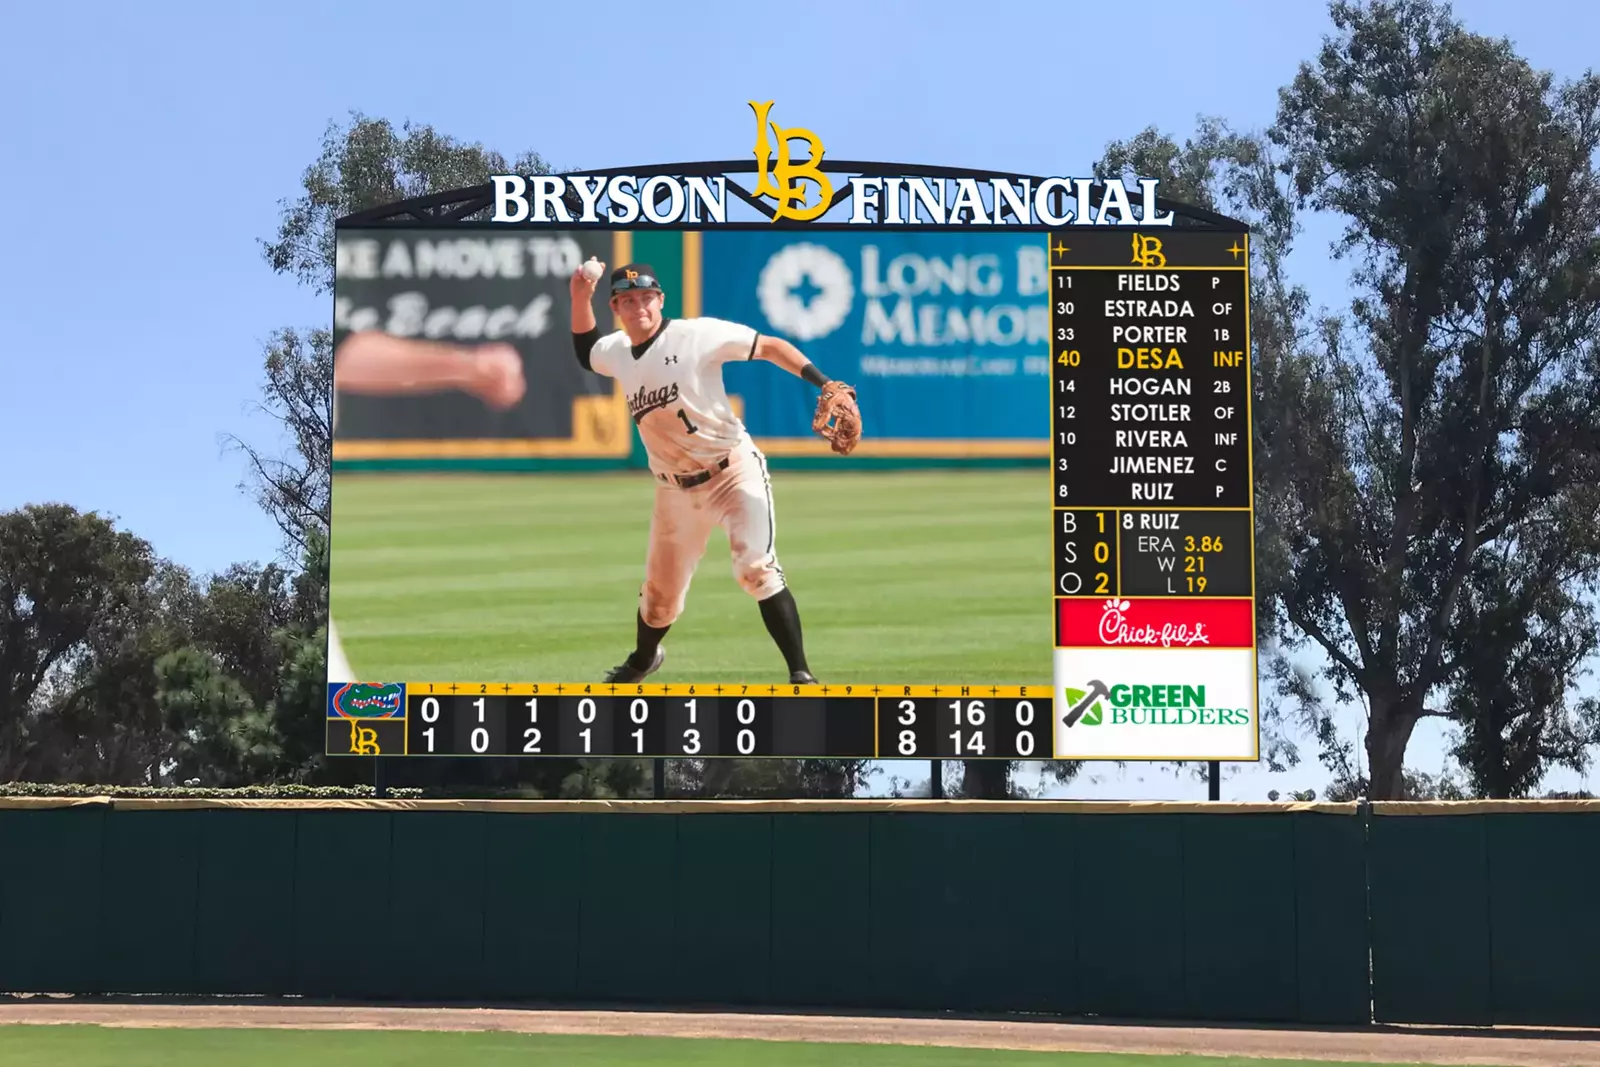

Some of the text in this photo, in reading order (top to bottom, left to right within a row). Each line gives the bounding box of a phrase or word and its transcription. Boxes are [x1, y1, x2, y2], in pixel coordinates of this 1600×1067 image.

[491, 174, 1174, 226] BRYSON FINANCIAL
[1059, 275, 1219, 291] 11 FIELDS P
[1058, 300, 1232, 317] 30 ESTRADA OF
[1058, 326, 1229, 343] 33 PORTER 1B
[1058, 351, 1080, 366] 40
[1118, 348, 1183, 369] DESA
[1214, 352, 1243, 367] INF
[1060, 378, 1230, 395] 14 HOGAN 2B
[1060, 404, 1234, 421] 12 STOTLER OF
[677, 409, 698, 434] 1
[1060, 431, 1237, 447] 10 RIVERA INF
[1059, 457, 1226, 473] 3 JIMENEZ C
[1060, 483, 1223, 500] 8 RUIZ P
[1064, 513, 1104, 533] B 1
[1123, 513, 1179, 529] 8 RUIZ
[1065, 542, 1108, 563] S 0
[1139, 536, 1223, 552] ERA 3.86
[1158, 556, 1203, 572] W 21
[1095, 573, 1108, 593] 2
[1168, 577, 1207, 593] L 19
[1098, 597, 1210, 648] Chick-fil-A
[427, 683, 1027, 697] 1 2 3 4 5 6 7 8 9 R H E
[1110, 684, 1206, 708] GREEN
[422, 698, 1034, 725] 0 1 1 0 0 1 0 3 16 0
[1109, 708, 1250, 725] BUILDERS
[423, 728, 434, 752] 1
[471, 728, 489, 753] 0
[523, 728, 541, 752] 2
[579, 728, 590, 753] 1
[632, 729, 643, 753] 1
[683, 729, 700, 754] 3
[737, 729, 755, 754] 0
[898, 730, 916, 755] 8
[950, 730, 985, 755] 14
[1016, 731, 1034, 755] 0
